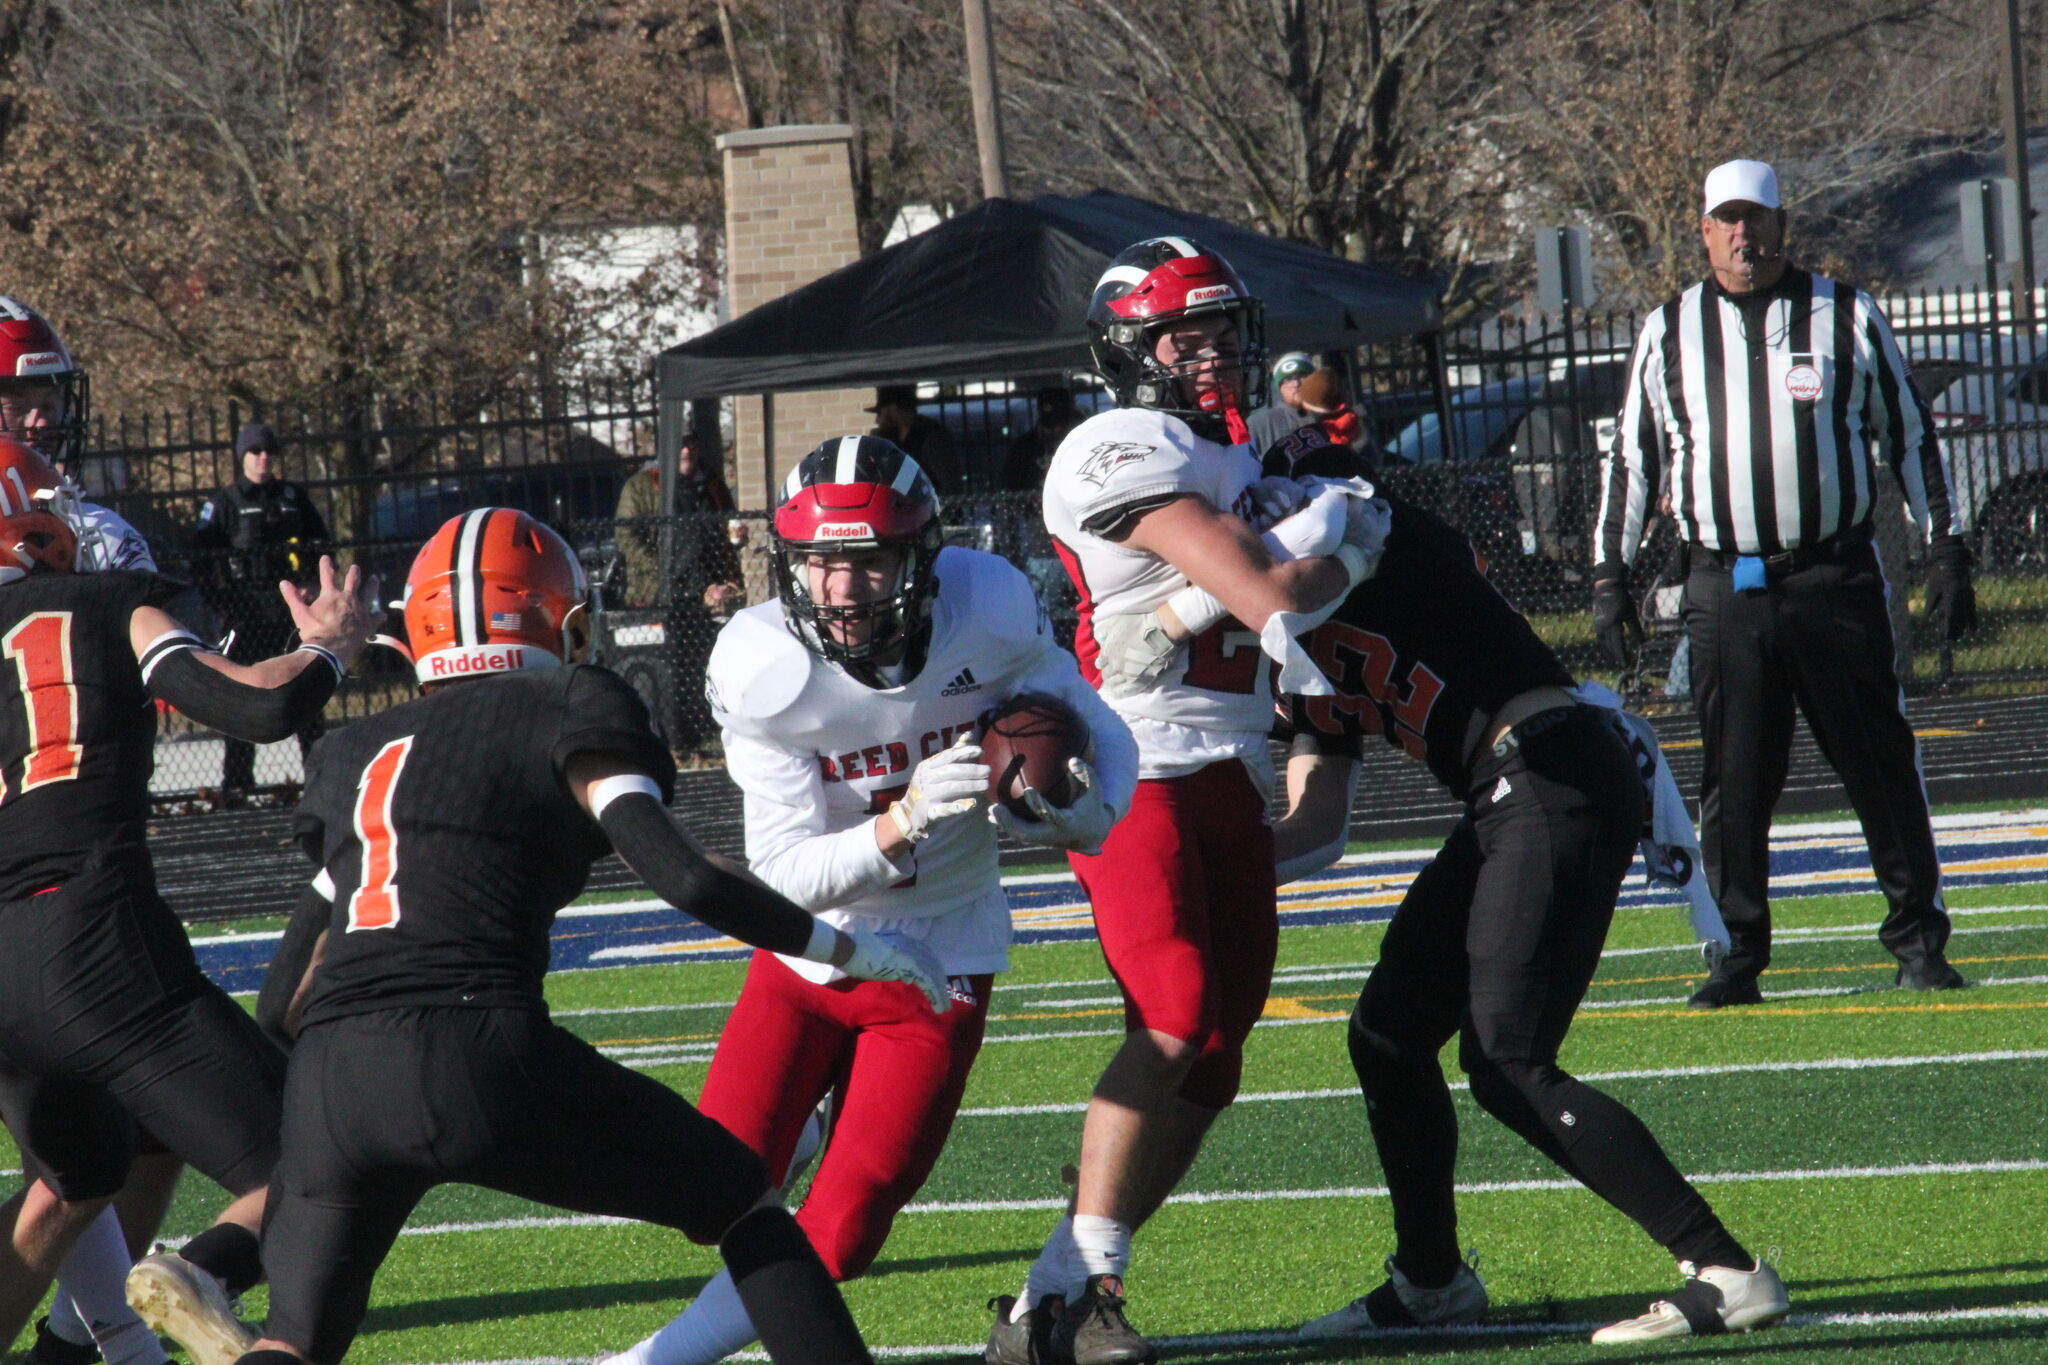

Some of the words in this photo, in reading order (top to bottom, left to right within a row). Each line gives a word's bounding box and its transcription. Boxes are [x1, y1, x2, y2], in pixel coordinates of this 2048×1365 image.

[822, 525, 868, 537] Riddell
[431, 649, 524, 676] Riddell
[0, 611, 84, 806] 1
[819, 741, 910, 783] REED
[346, 734, 415, 934] 1
